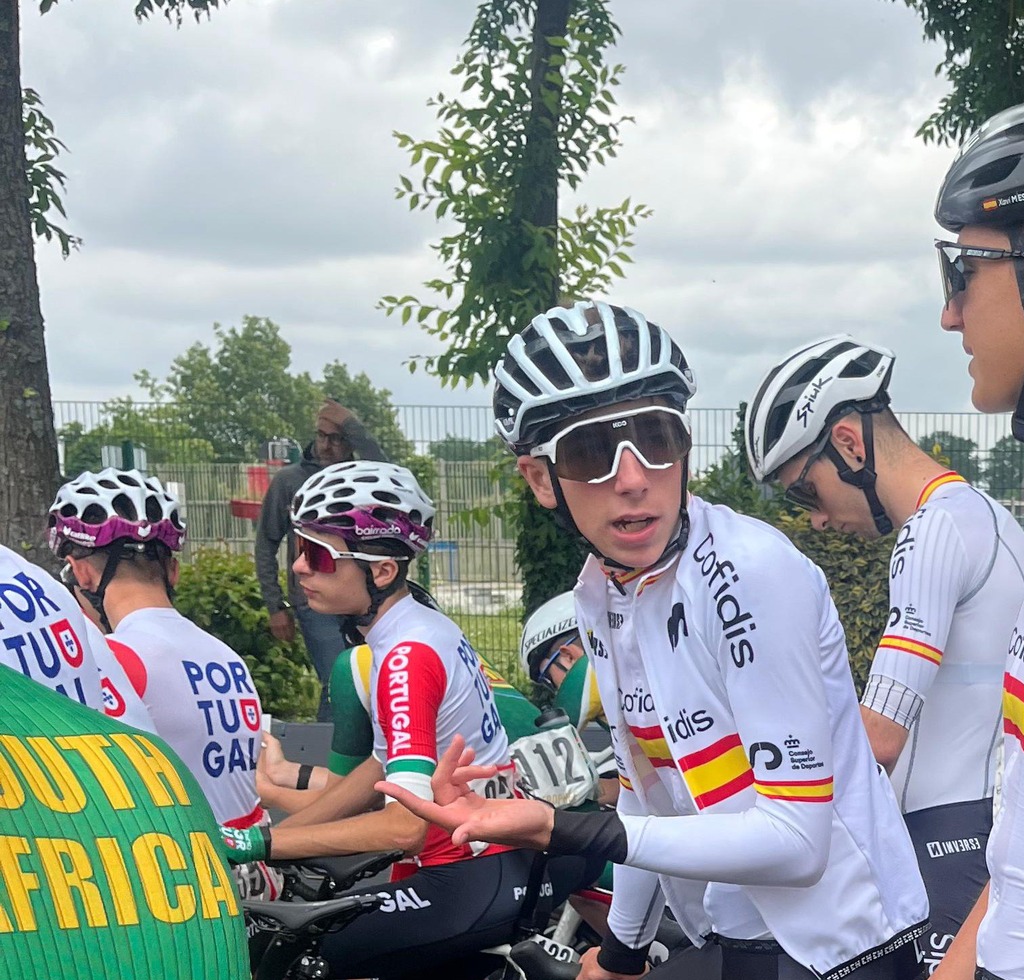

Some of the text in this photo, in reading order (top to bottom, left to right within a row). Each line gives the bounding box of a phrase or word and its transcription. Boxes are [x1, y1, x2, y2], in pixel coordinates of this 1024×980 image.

[693, 532, 757, 669] Cofidis
[182, 660, 254, 695] POR
[388, 645, 413, 755] PORTUGAL
